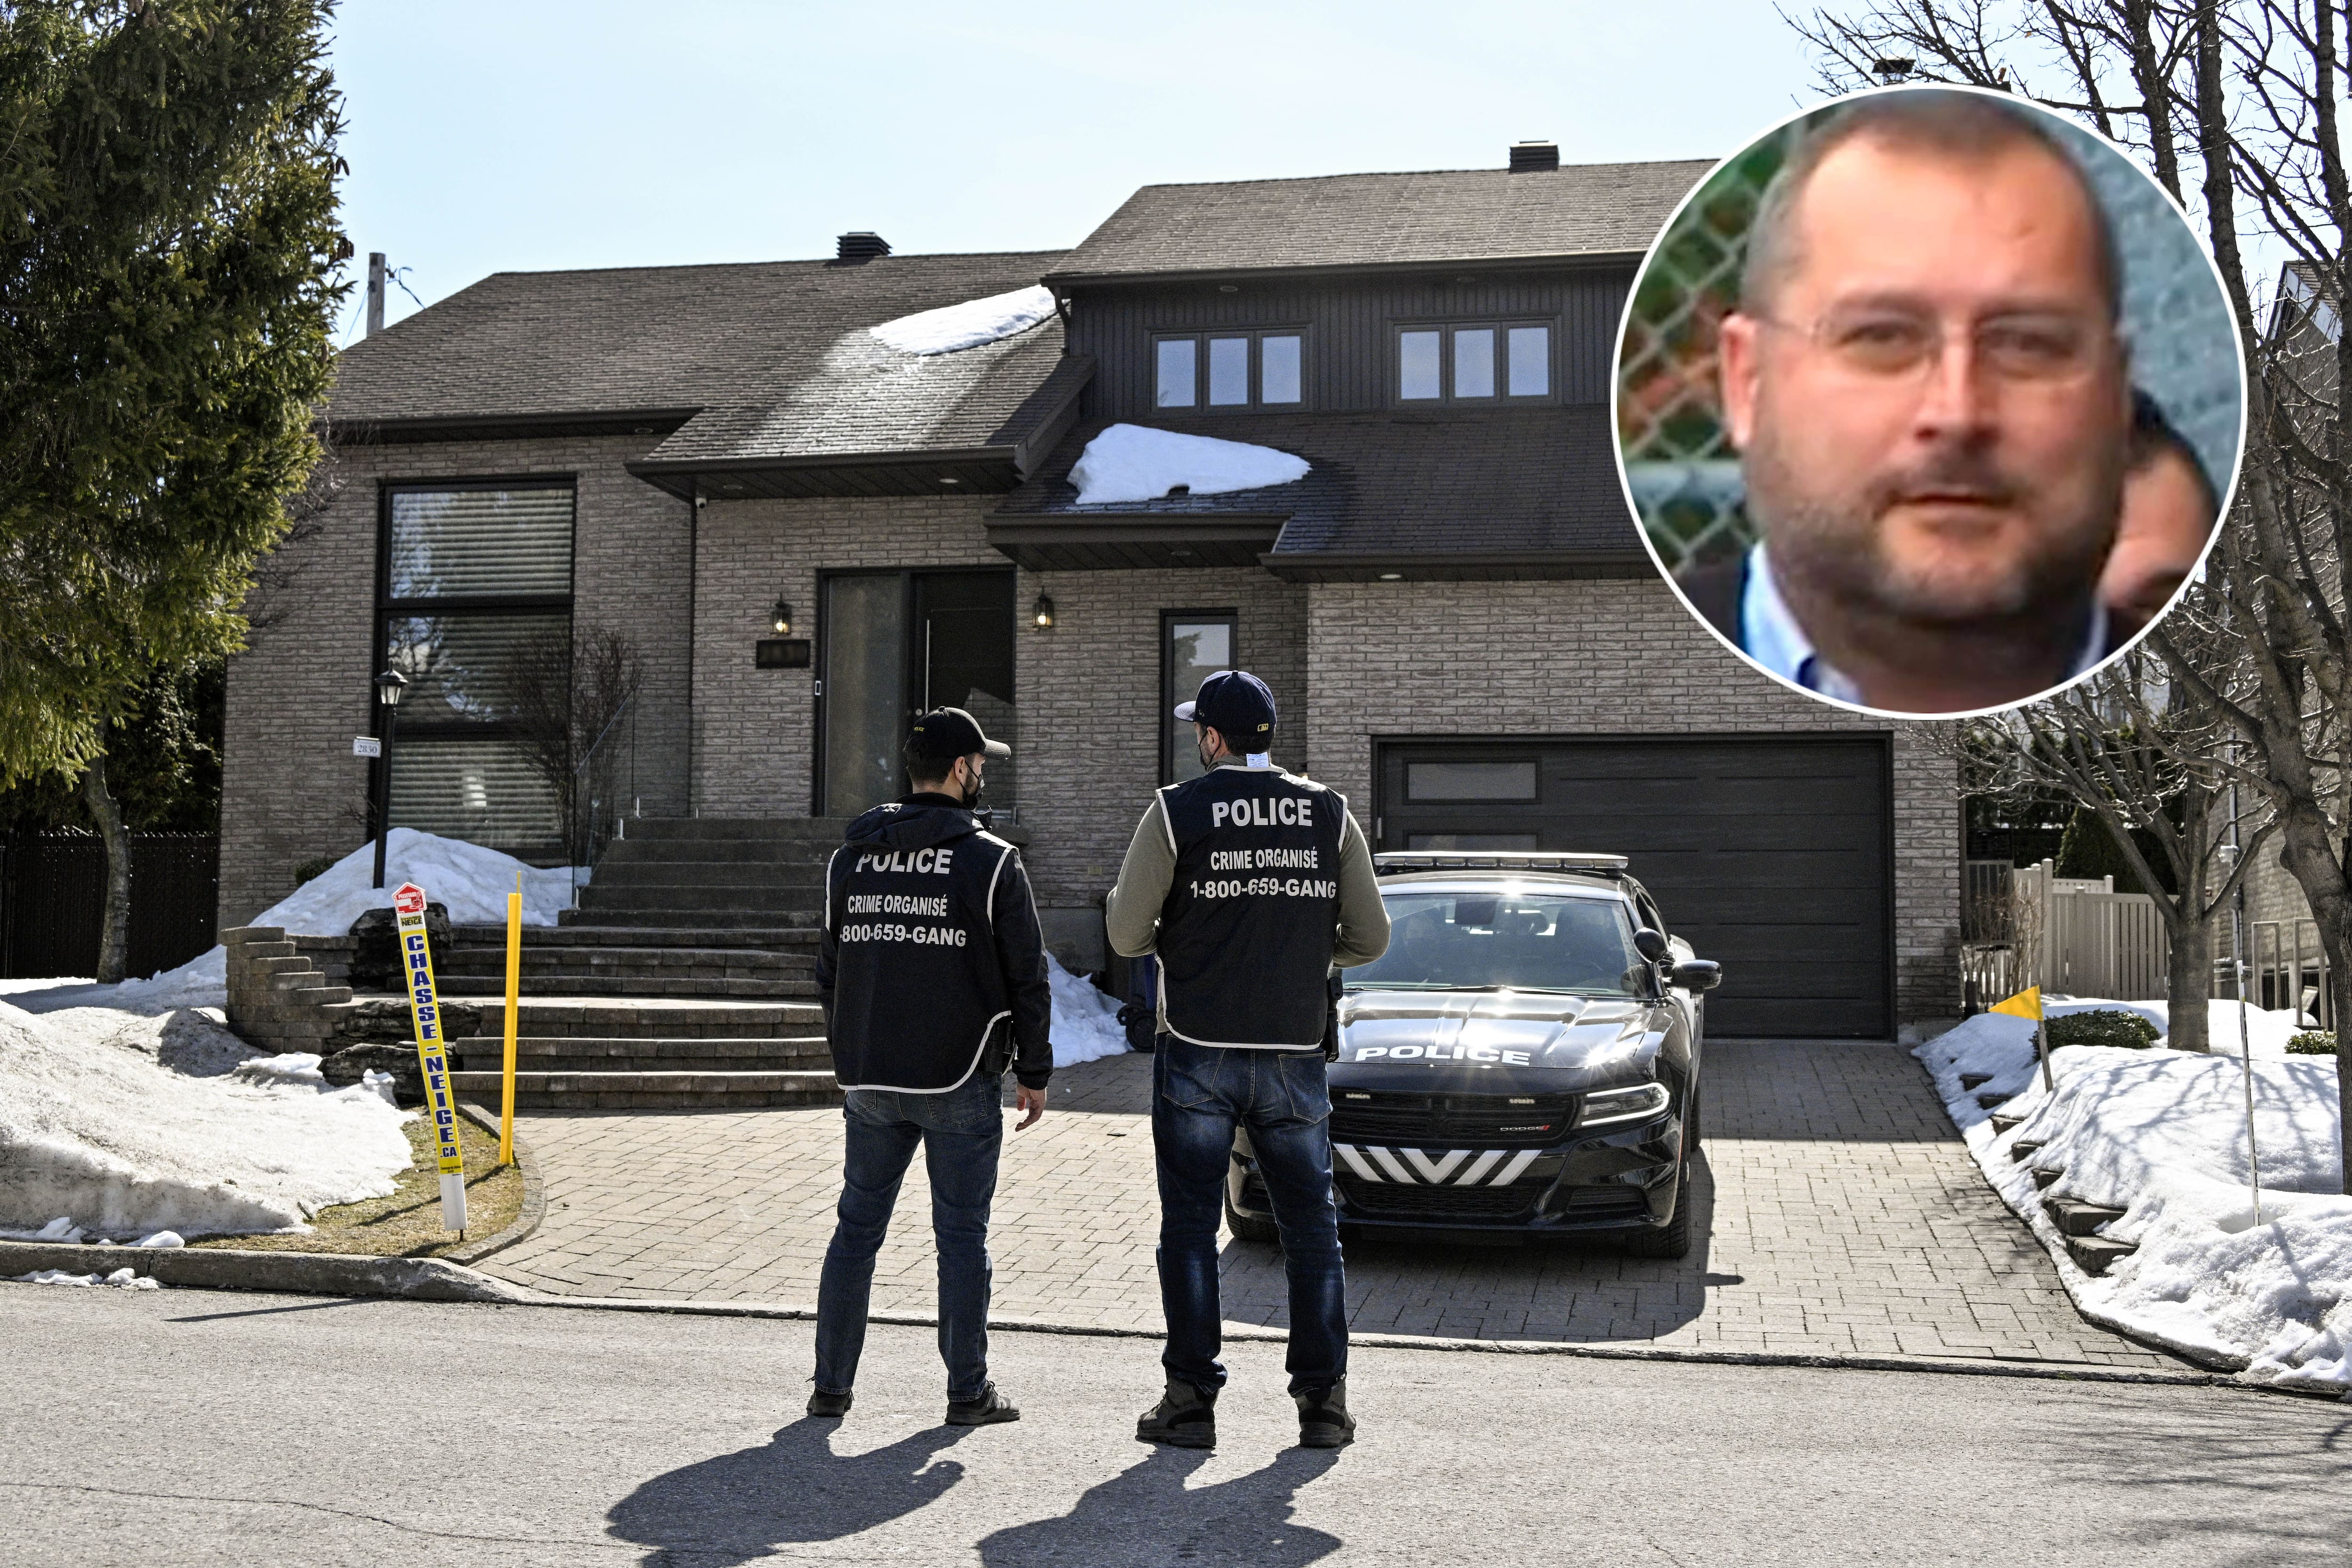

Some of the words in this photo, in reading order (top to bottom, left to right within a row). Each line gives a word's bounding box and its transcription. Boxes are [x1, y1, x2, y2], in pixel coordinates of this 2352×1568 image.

[358, 745, 377, 754] 2830
[1212, 798, 1312, 827] POLICE
[855, 848, 954, 874] POLICE
[1211, 850, 1252, 870] CRIME
[1255, 846, 1318, 869] ORGANISÉ
[1190, 878, 1336, 899] 1-800-659-GANG
[848, 895, 882, 913] CRIME
[883, 894, 947, 916] ORGANISÉ
[402, 918, 422, 926] NEIGE
[1355, 1045, 1531, 1066] POLICE
[440, 1146, 457, 1157] .CA
